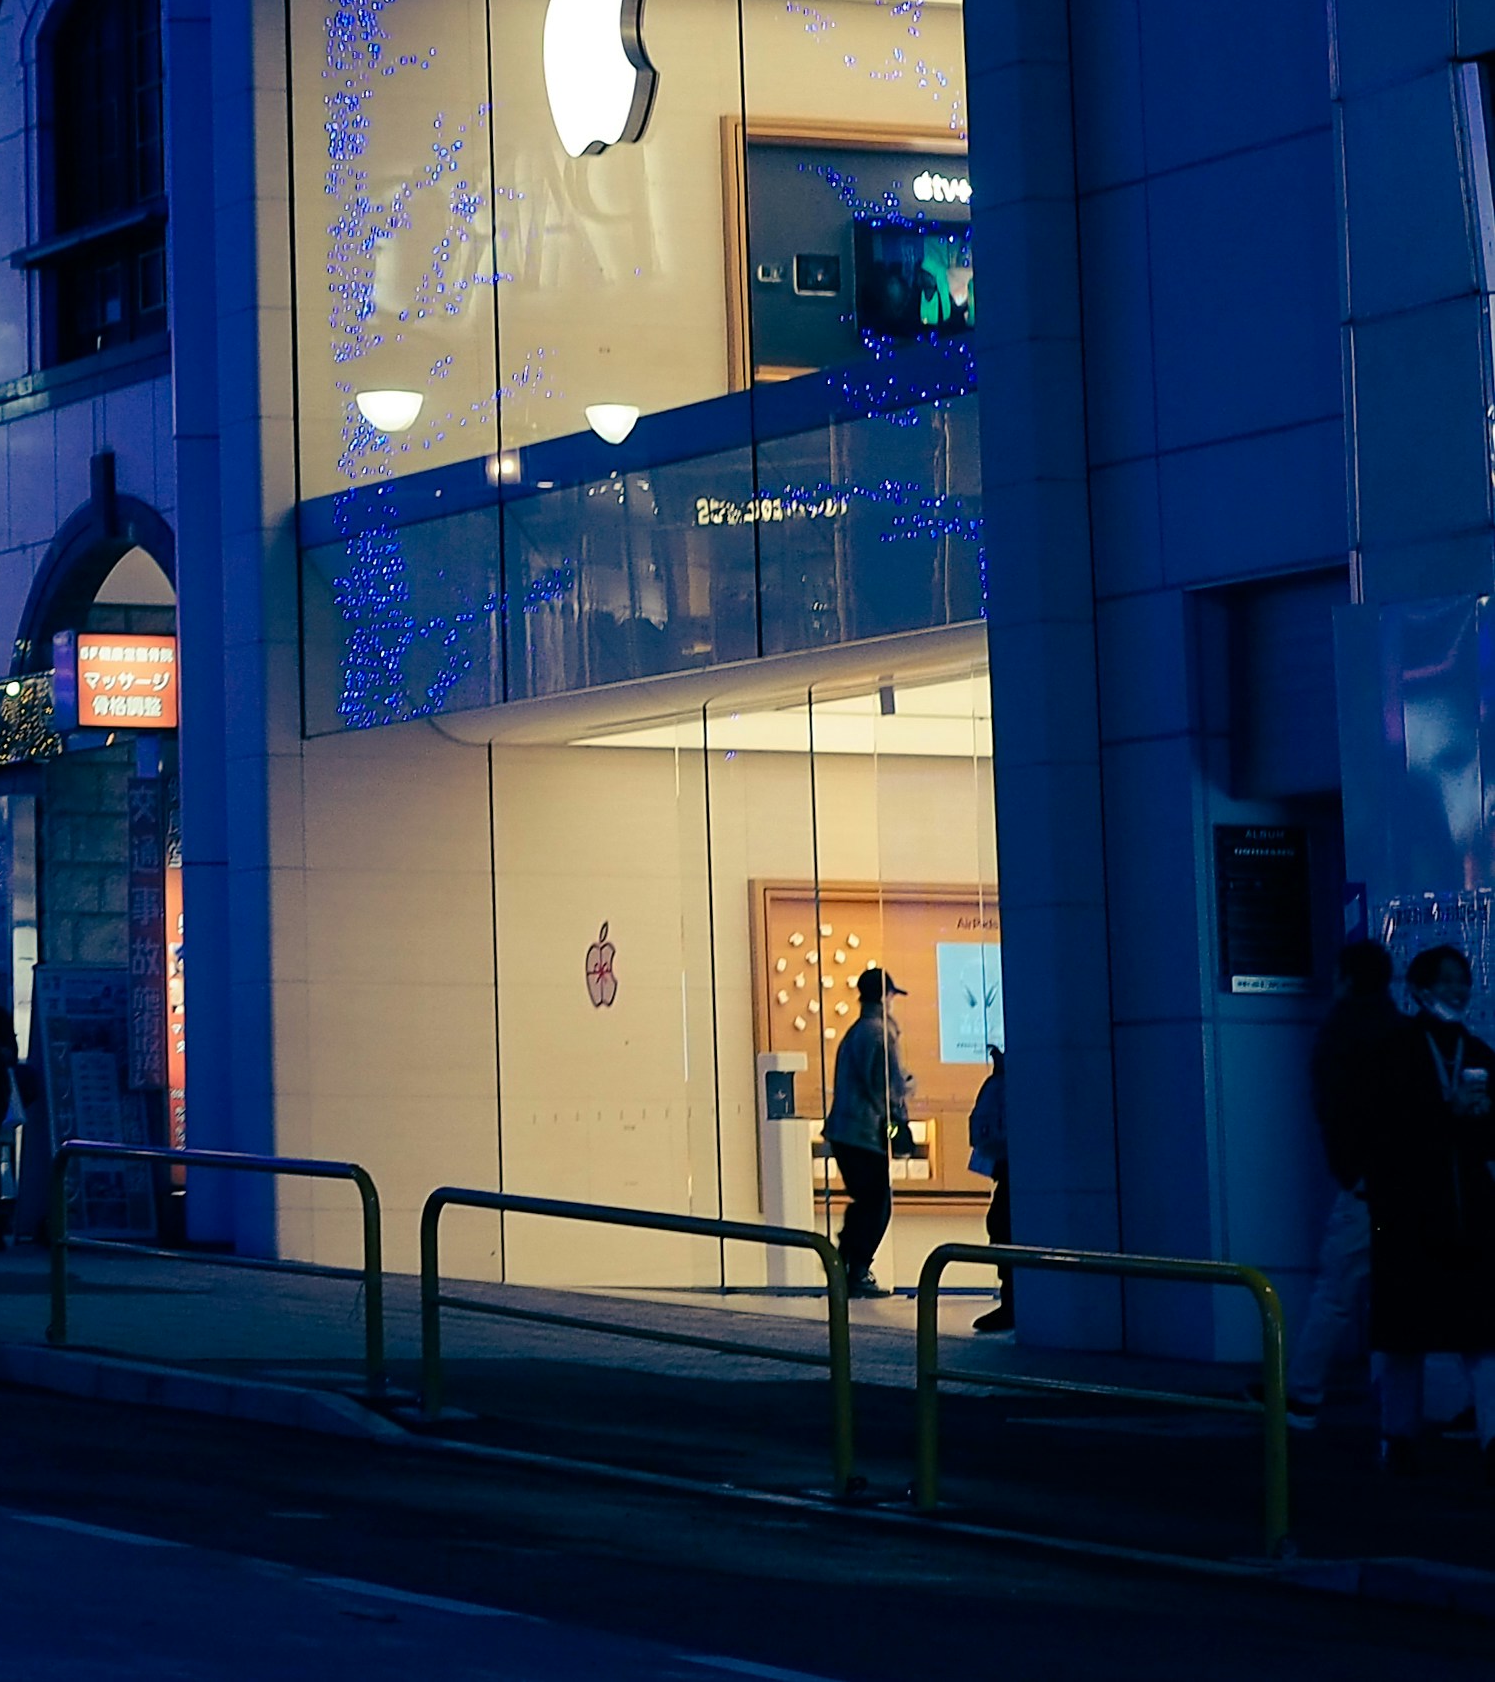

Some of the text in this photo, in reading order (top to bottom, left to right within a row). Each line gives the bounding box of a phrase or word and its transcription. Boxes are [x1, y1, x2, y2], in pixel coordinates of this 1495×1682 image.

[83, 671, 171, 692] マッサージ
[91, 694, 163, 718] 骨格調整
